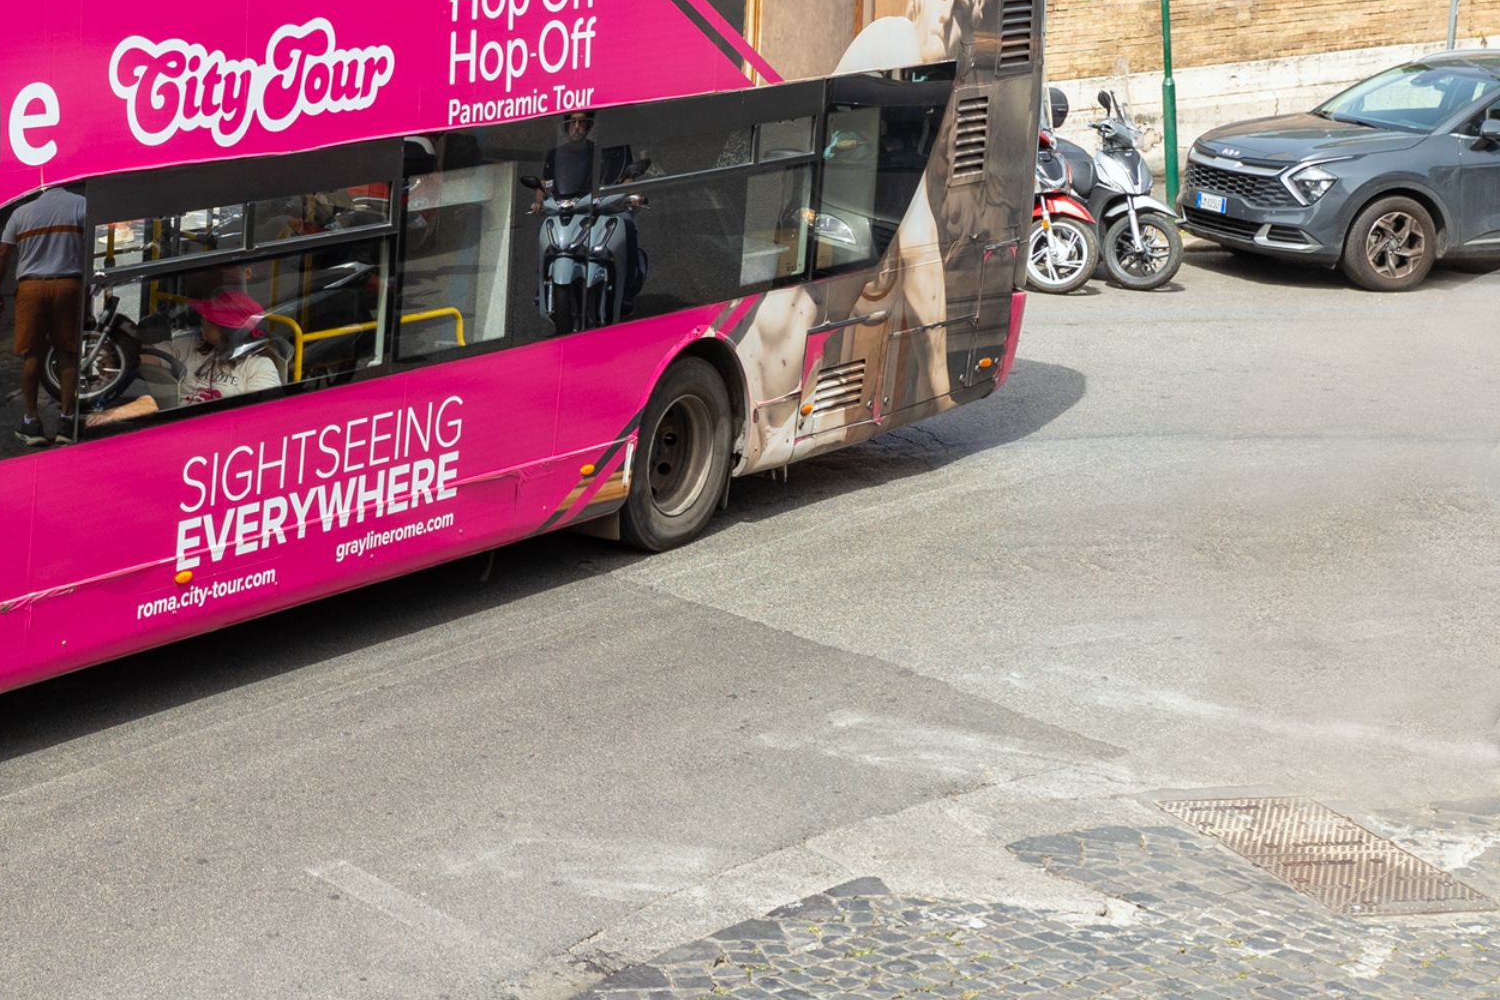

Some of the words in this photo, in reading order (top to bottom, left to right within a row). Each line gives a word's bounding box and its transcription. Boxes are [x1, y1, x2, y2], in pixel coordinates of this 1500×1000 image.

[112, 38, 253, 144] City
[259, 21, 392, 129] Tour
[448, 15, 597, 93] Hop-Off
[447, 88, 549, 126] Panoramic
[552, 84, 595, 111] Tour
[179, 395, 464, 513] SIGHTSEEING
[175, 450, 460, 572] EVERYWHERE
[335, 512, 454, 562] graylinerome.com
[136, 568, 277, 620] roma.city-tour.com
